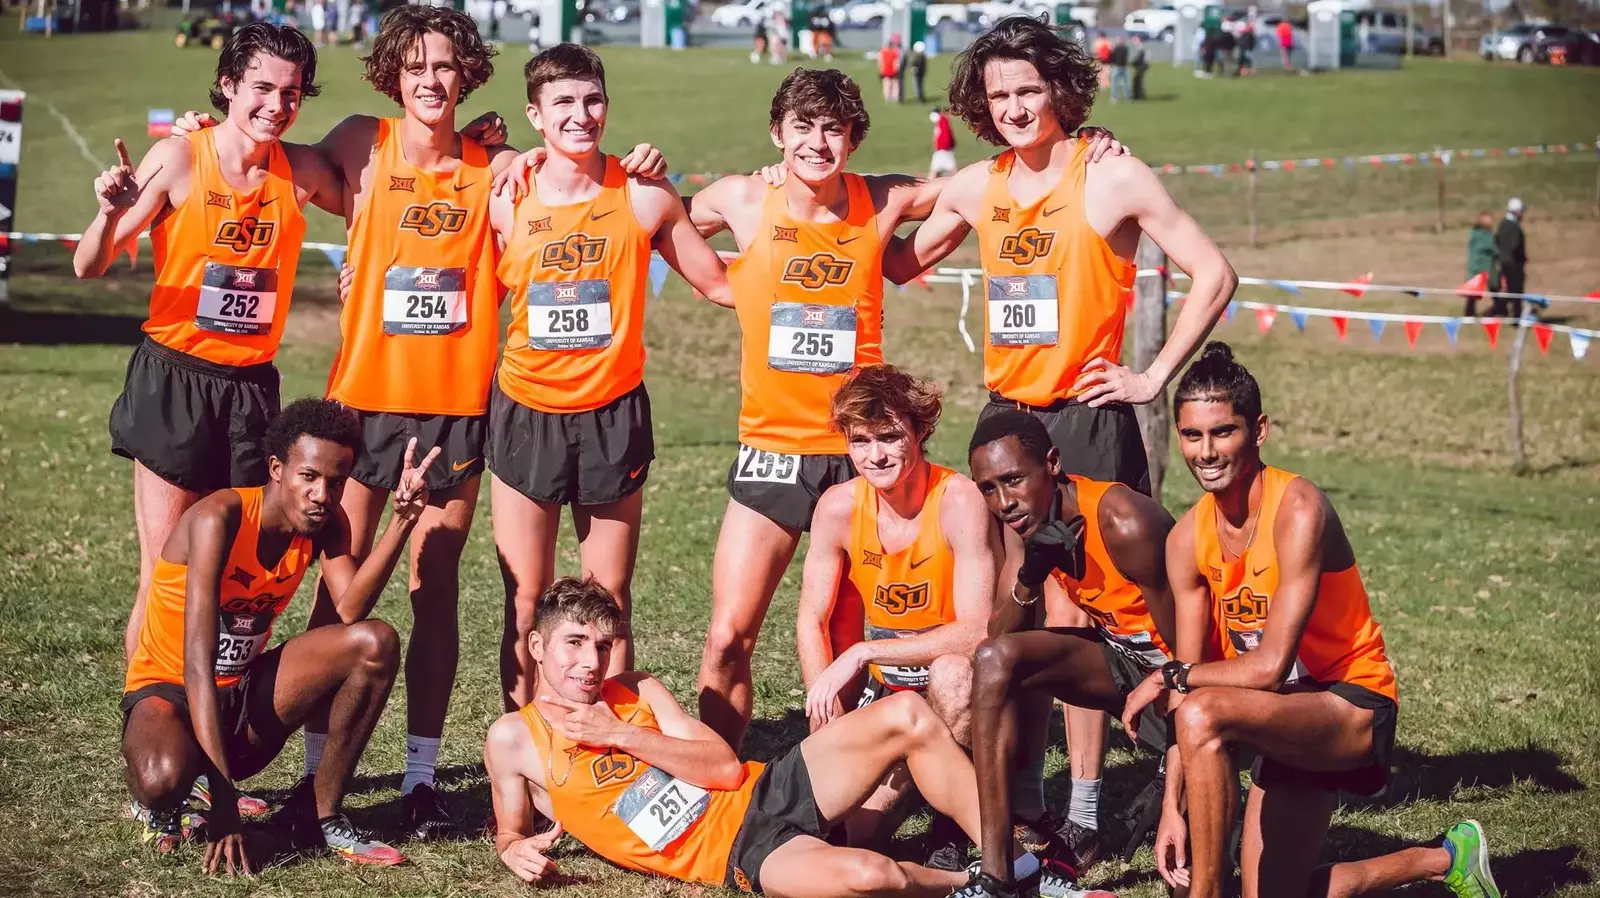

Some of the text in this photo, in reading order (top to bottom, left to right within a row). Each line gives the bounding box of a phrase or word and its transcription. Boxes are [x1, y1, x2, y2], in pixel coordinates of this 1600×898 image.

[214, 216, 275, 253] OSU
[400, 202, 468, 237] OSU
[541, 233, 608, 272] OSU
[999, 227, 1057, 266] OSU
[783, 252, 855, 289] OSU
[219, 292, 260, 319] 252
[406, 294, 447, 319] 254
[548, 308, 589, 333] 258
[1003, 303, 1036, 328] 260
[791, 331, 834, 357] 255
[739, 444, 795, 480] 255
[874, 581, 930, 615] OSU
[1222, 586, 1268, 623] OSU
[219, 637, 254, 662] 253
[649, 784, 689, 828] 257
